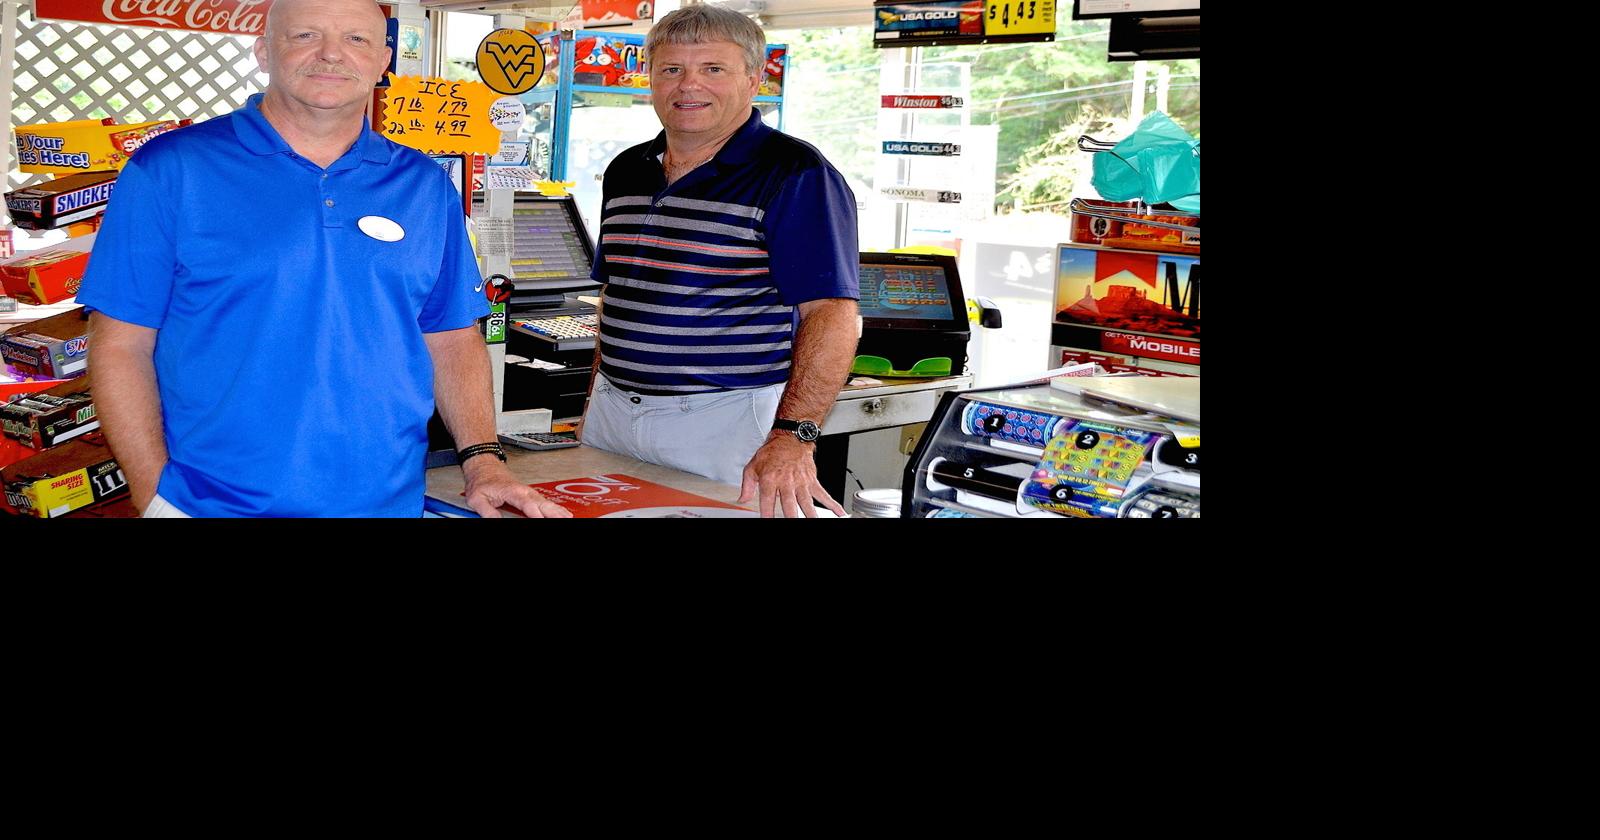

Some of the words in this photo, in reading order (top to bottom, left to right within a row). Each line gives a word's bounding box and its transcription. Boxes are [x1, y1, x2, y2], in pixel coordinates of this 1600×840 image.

[102, 0, 263, 33] CocaCola
[900, 13, 924, 21] USA
[925, 12, 957, 20] GOLD
[418, 81, 466, 101] ICE
[394, 97, 405, 114] 7
[438, 100, 469, 115] 1.79
[893, 97, 938, 108] Winston
[388, 121, 406, 134] 22
[435, 120, 470, 135] 4.99
[27, 135, 63, 151] Your
[886, 144, 909, 152] USA
[40, 152, 90, 168] Here!
[881, 187, 925, 197] SONOMA
[8, 199, 33, 211] NICKERS
[34, 200, 40, 210] 2
[1130, 340, 1200, 358] MOBILE
[991, 417, 999, 428] 1
[1082, 434, 1095, 446] 2
[1185, 453, 1198, 464] 3
[963, 467, 974, 478] 5
[51, 474, 83, 489] SHARING
[67, 481, 84, 490] SIZE
[1056, 488, 1068, 499] 6
